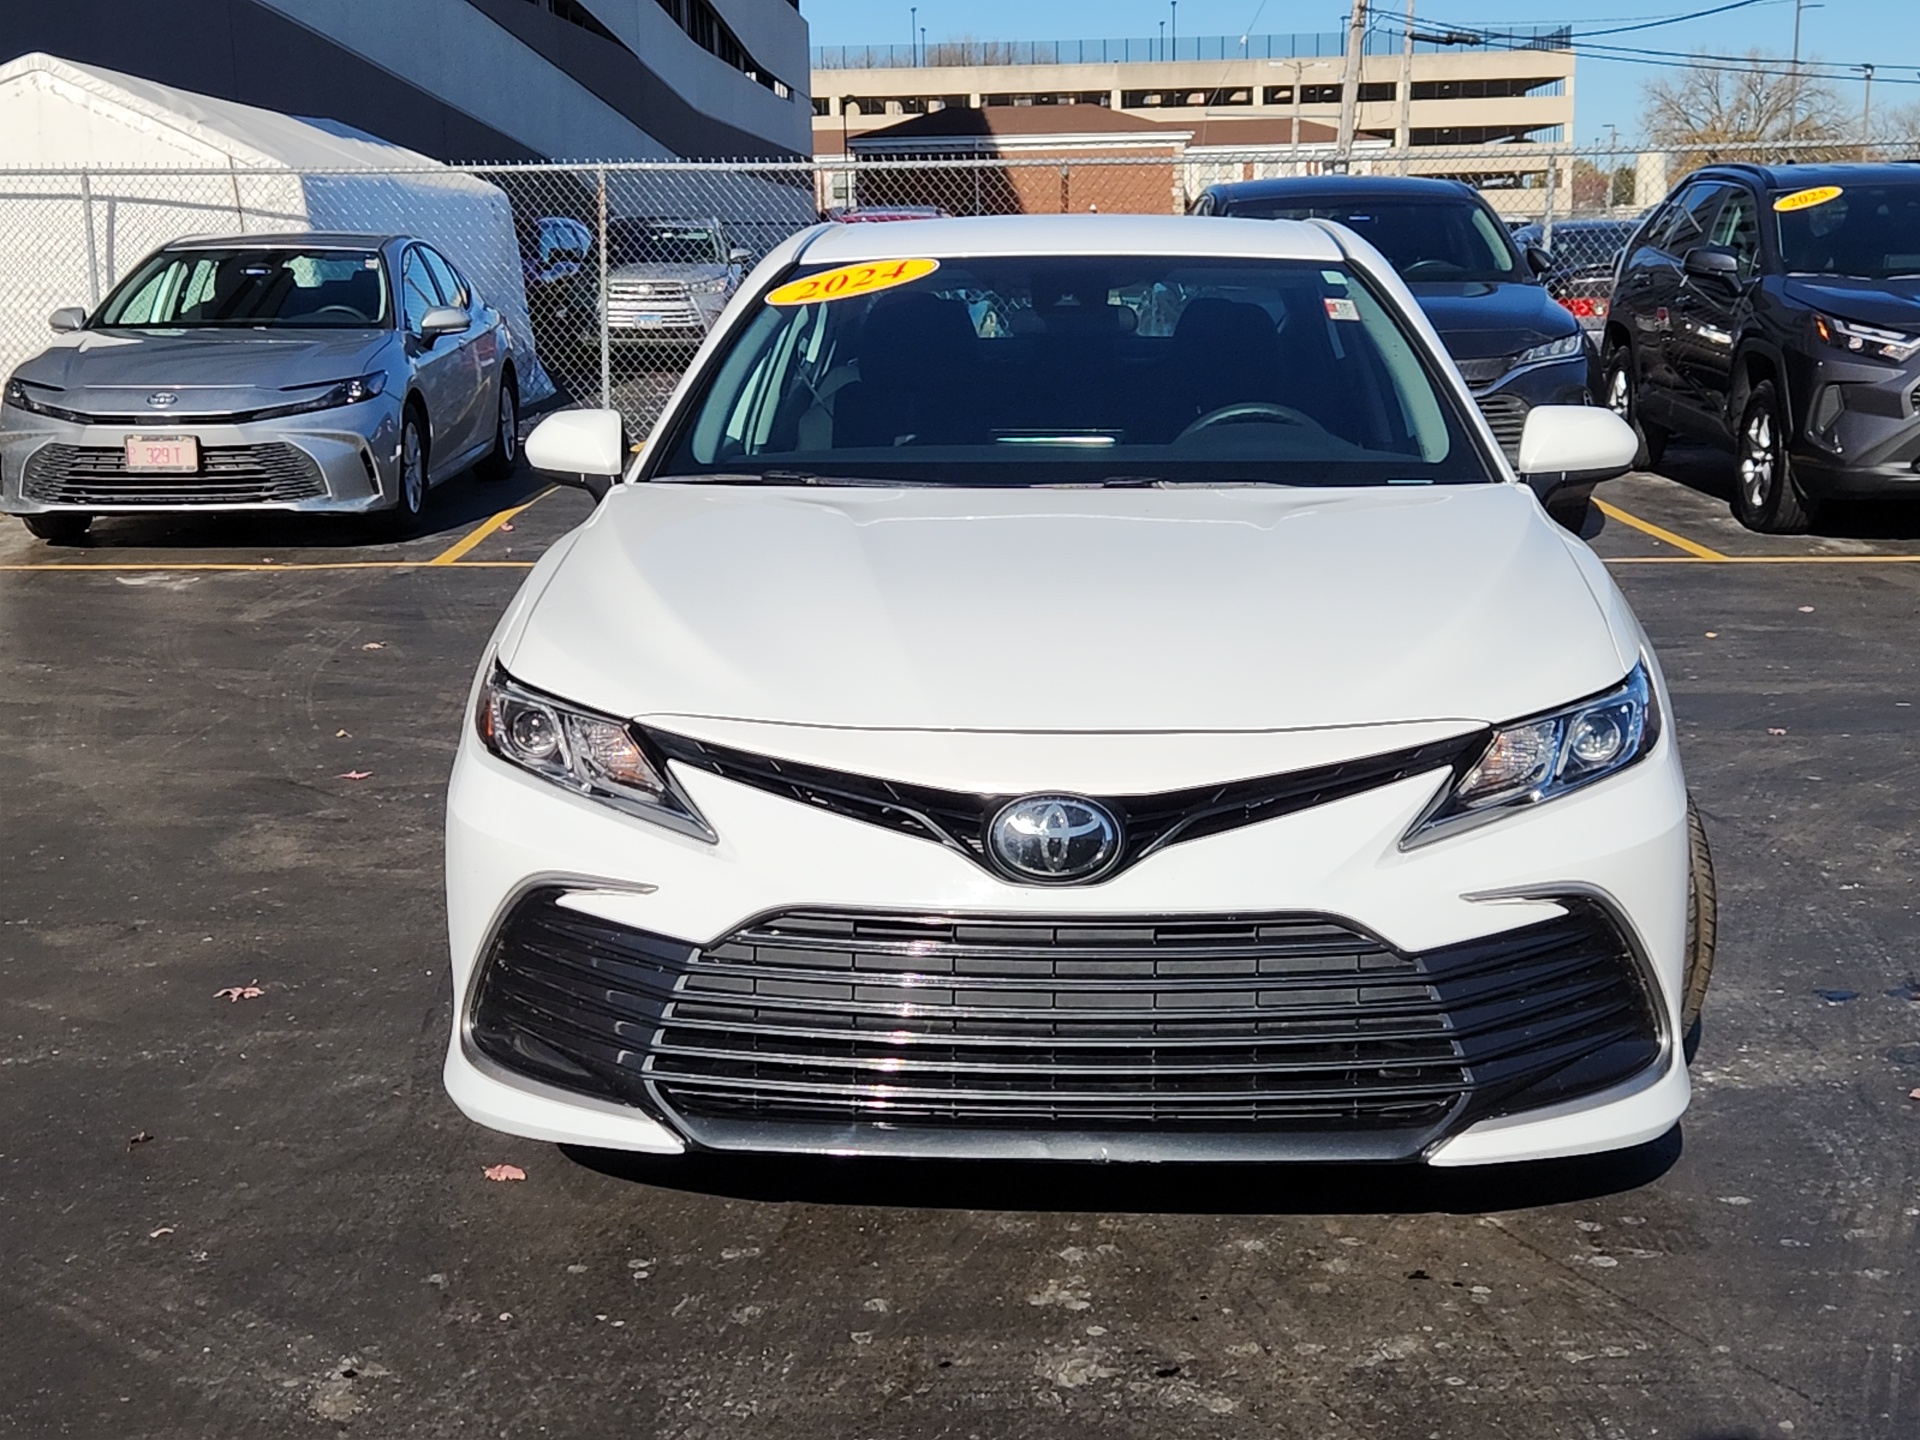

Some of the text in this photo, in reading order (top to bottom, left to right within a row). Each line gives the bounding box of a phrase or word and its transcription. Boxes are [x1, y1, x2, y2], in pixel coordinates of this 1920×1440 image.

[1789, 190, 1828, 207] 2025
[794, 260, 909, 301] 2024
[145, 447, 170, 464] 329
[173, 447, 181, 464] T
